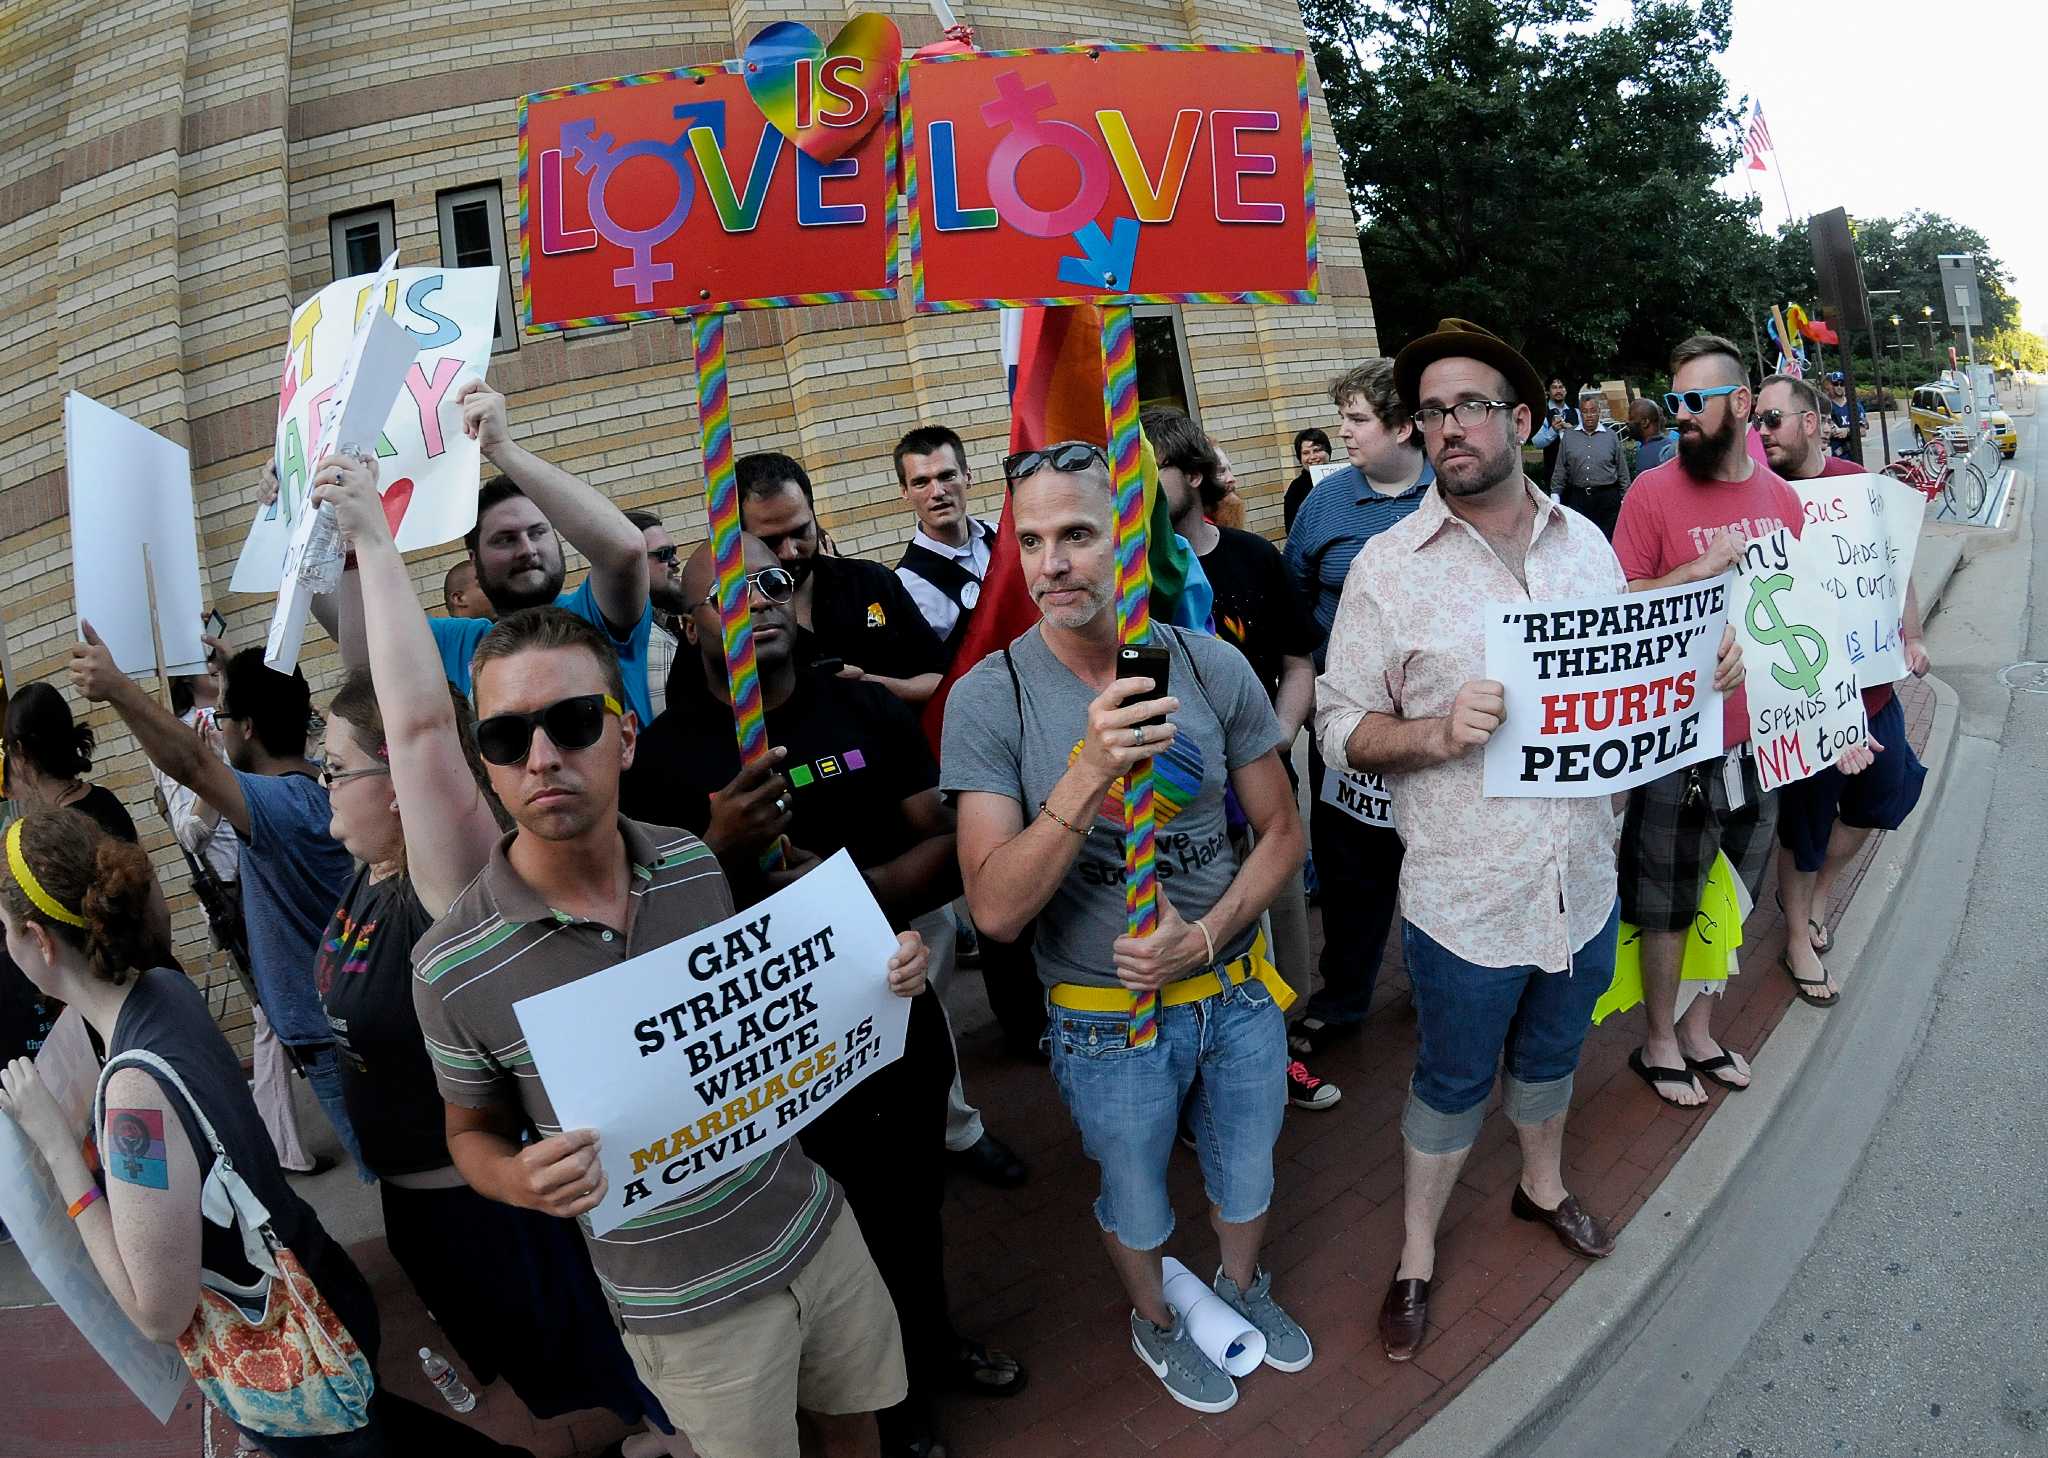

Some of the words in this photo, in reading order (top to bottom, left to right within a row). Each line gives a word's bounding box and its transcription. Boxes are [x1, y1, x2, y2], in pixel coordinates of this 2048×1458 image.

[540, 112, 866, 262] LOVE
[795, 55, 869, 129] IS
[927, 108, 1286, 237] LOVE
[1502, 583, 1725, 643] "REPARATIVE
[1533, 625, 1706, 680] THERAPY"
[1540, 670, 1697, 735] HURTS
[1758, 692, 1827, 735] SPENDS
[1834, 673, 1858, 710] IN
[1520, 711, 1700, 782] PEOPLE
[1757, 729, 1811, 789] NM
[1816, 711, 1867, 763] too!
[1178, 831, 1226, 875] Hate
[688, 913, 773, 982] GAY
[634, 925, 836, 1058] STRAIGHT
[683, 982, 819, 1078] BLACK
[694, 1019, 820, 1108] WHITE
[622, 1178, 652, 1208] A
[662, 1121, 767, 1185] CIVIL
[776, 1035, 882, 1131] RIGHT!
[629, 1041, 837, 1175] MARRIAGE
[844, 1015, 874, 1055] IS
